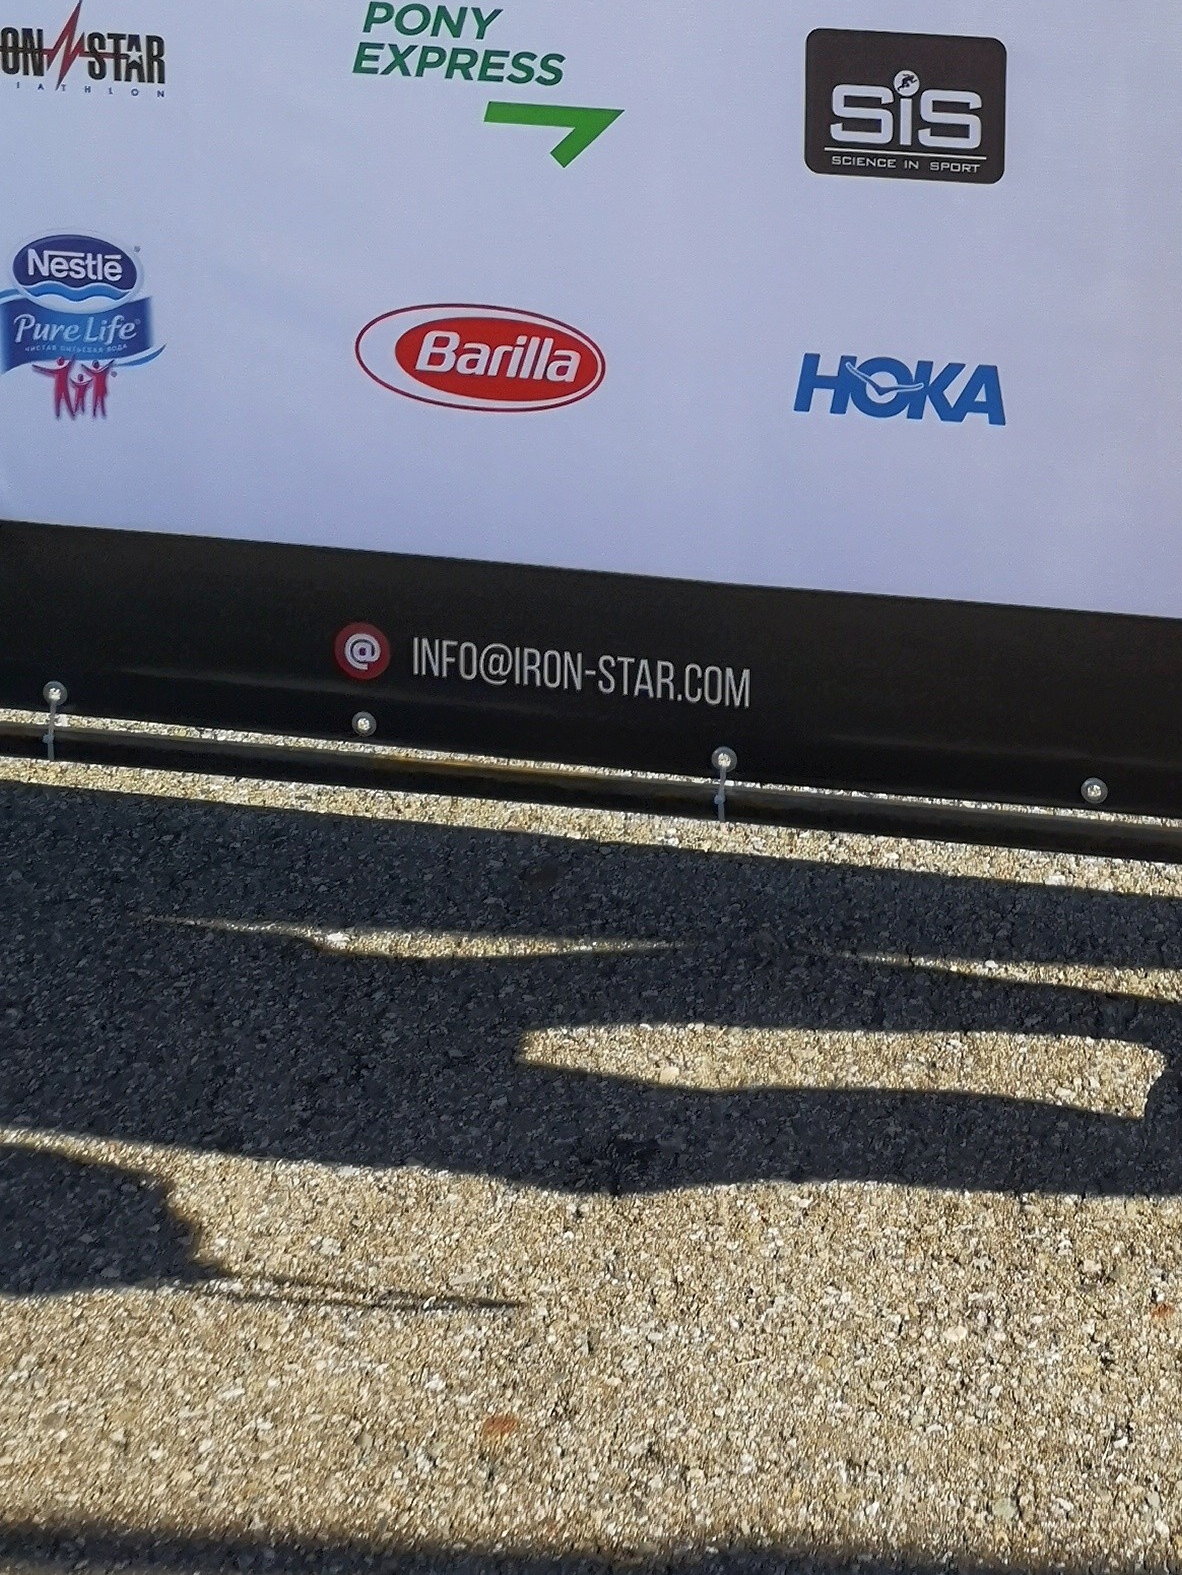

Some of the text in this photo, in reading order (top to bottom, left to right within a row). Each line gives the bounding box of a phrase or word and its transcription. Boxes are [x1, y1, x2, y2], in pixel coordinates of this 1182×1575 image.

[362, 1, 503, 40] PONY
[86, 31, 165, 84] STAR
[352, 42, 566, 87] EXPRESS
[16, 81, 165, 98] IATHLON
[831, 155, 980, 174] SCIENCE IN SPORT
[13, 313, 138, 345] Pure Life
[414, 329, 582, 383] Barilla
[793, 352, 1006, 426] HOKA
[412, 636, 751, 708] INFO@IRON-STAR.COM
